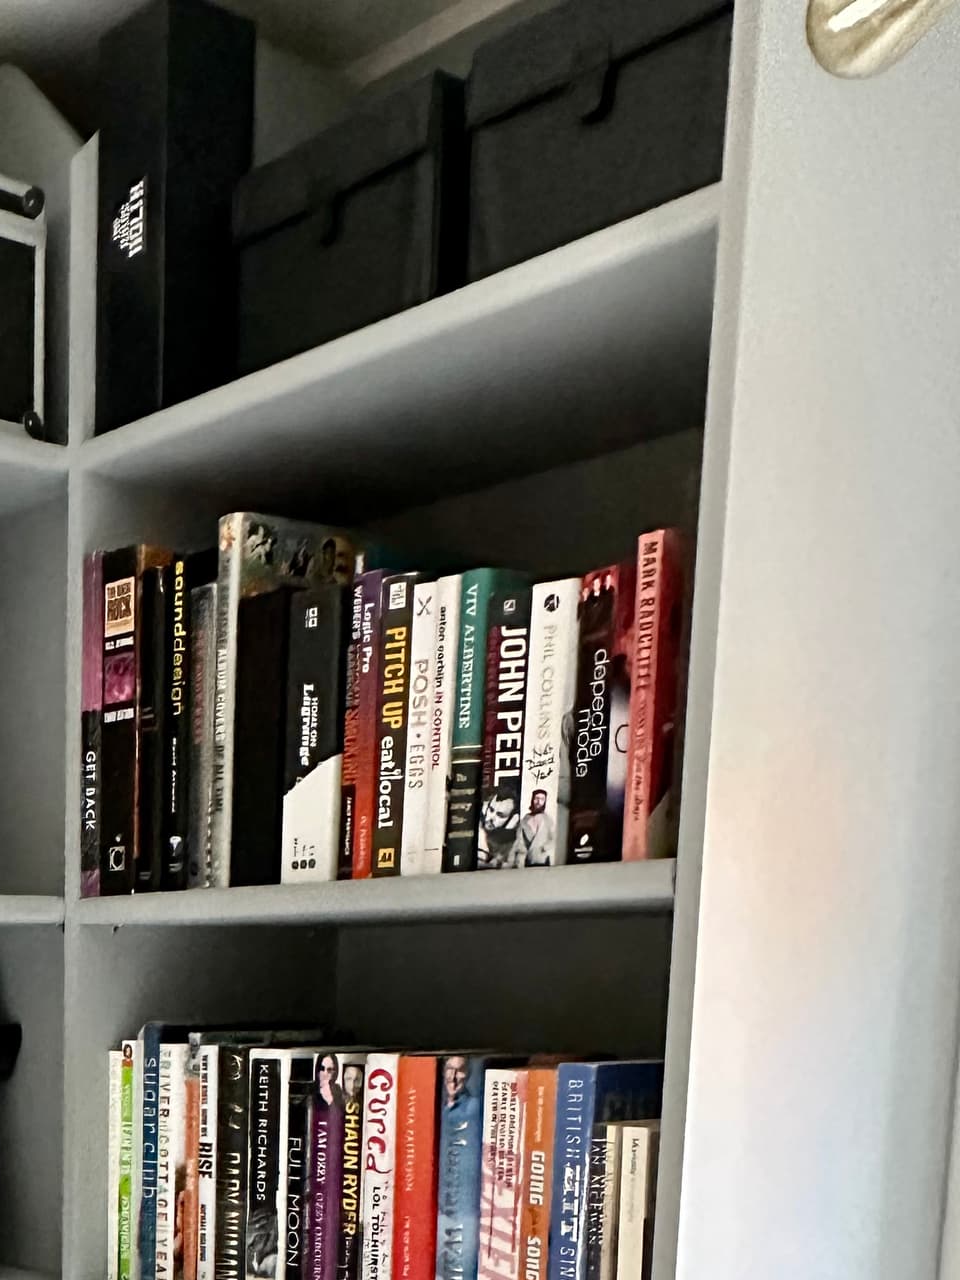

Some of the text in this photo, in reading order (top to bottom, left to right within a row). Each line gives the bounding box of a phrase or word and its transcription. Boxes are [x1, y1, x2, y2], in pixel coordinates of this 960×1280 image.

[640, 542, 658, 591] MARK
[360, 646, 375, 673] Pro
[382, 627, 407, 695] PITCH
[458, 583, 478, 729] VIV ALBERTINE
[537, 623, 557, 740] PHIL COLLINS
[214, 694, 228, 741] COVERS
[381, 701, 404, 730] UP
[408, 658, 429, 790] POSH EGGS
[493, 625, 528, 787] JOHN PEEL
[588, 649, 610, 757] depeche
[430, 707, 442, 772] CONTROL
[575, 709, 591, 778] mode
[85, 750, 97, 831] GET BACK
[142, 1057, 159, 1199] sugar club
[255, 1064, 269, 1201] KEITH RICHARDS
[342, 1101, 360, 1169] SHAUN
[565, 1079, 583, 1159] BRITISH
[198, 1142, 214, 1180] RISE
[528, 1150, 545, 1206] GOING
[286, 1137, 302, 1267] FULL MOON
[341, 1173, 360, 1237] RYDER
[371, 1186, 381, 1212] LOL
